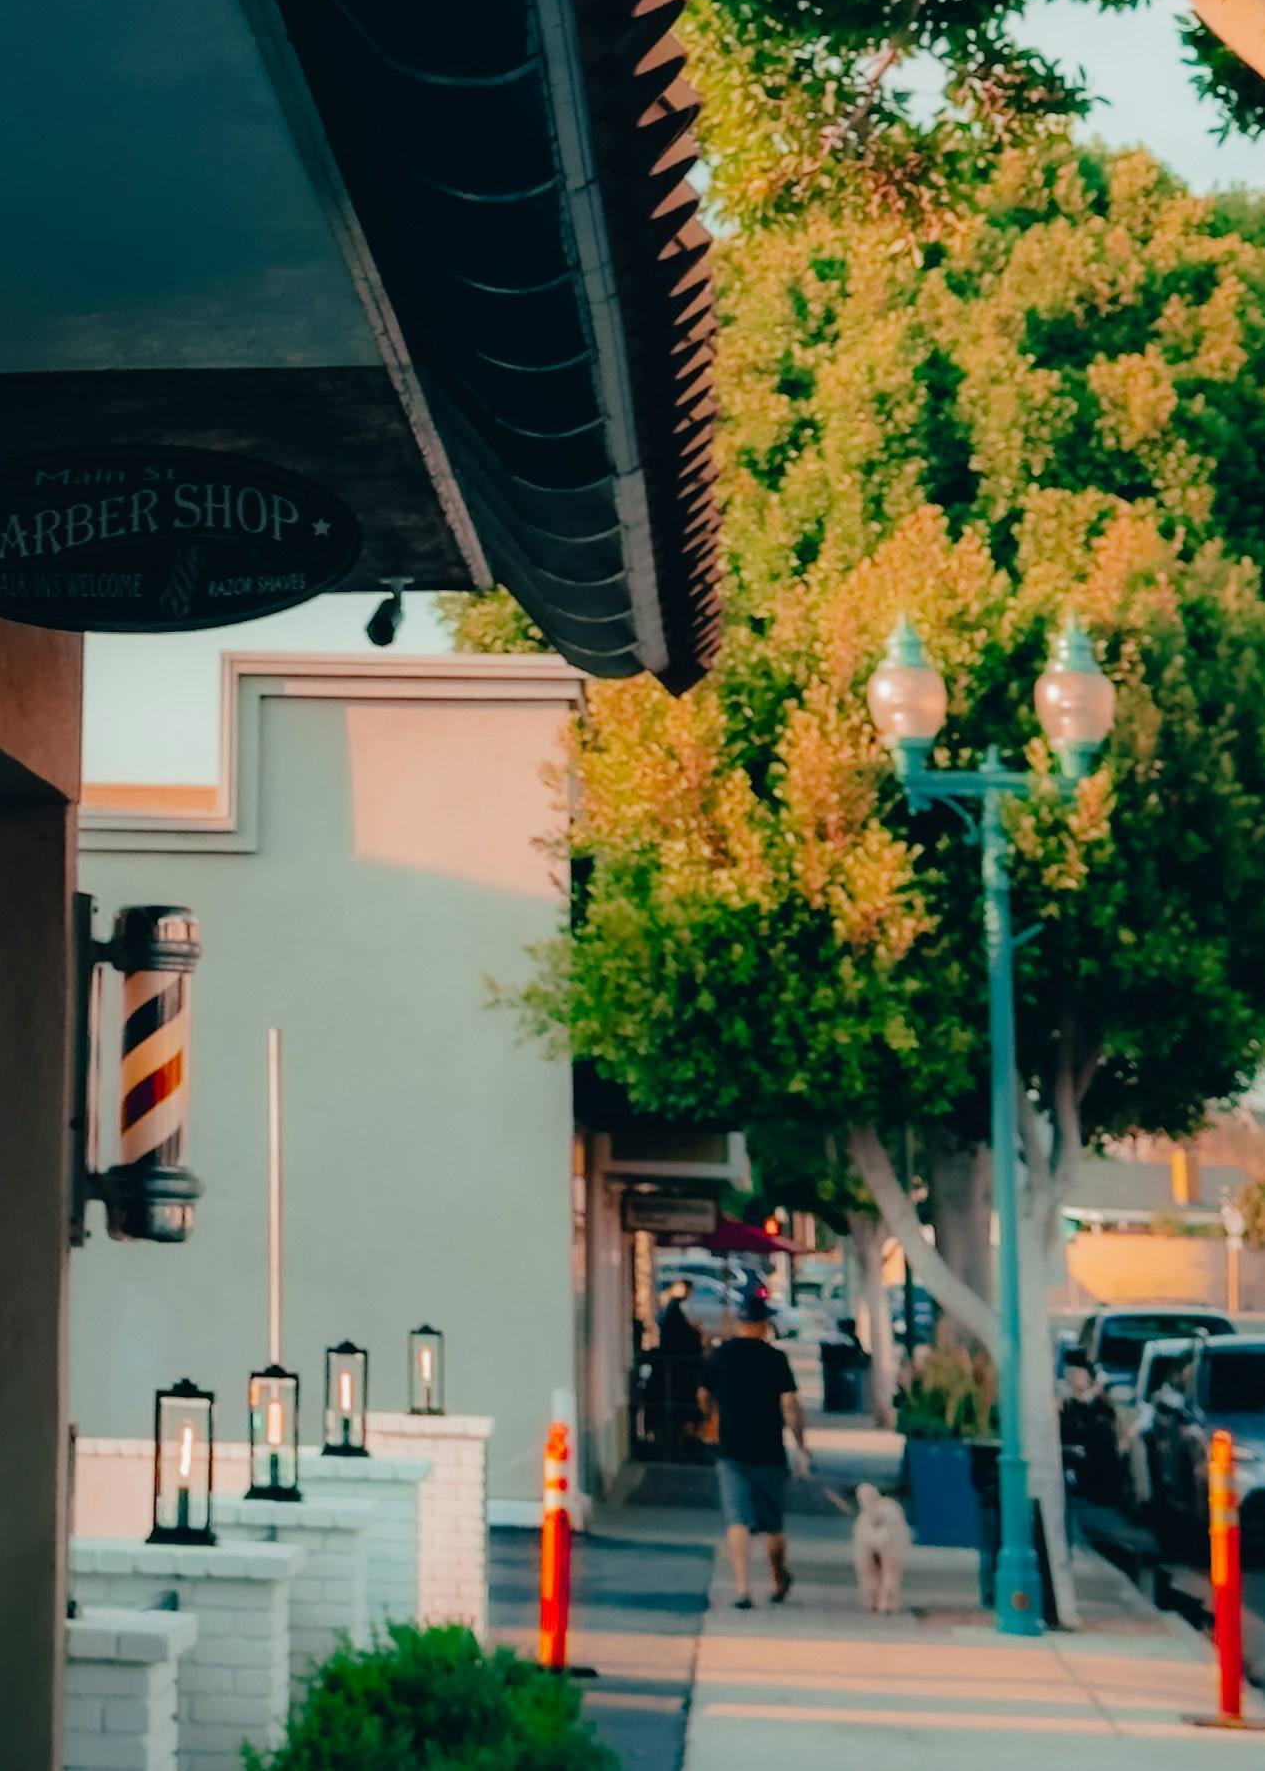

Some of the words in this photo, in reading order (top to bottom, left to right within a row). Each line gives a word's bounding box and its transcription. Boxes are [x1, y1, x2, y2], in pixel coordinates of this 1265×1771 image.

[33, 468, 125, 486] Main
[171, 482, 300, 541] SHOP
[64, 572, 143, 598] WELCOME
[208, 576, 252, 597] RAZOR
[256, 572, 307, 593] SHAVES
